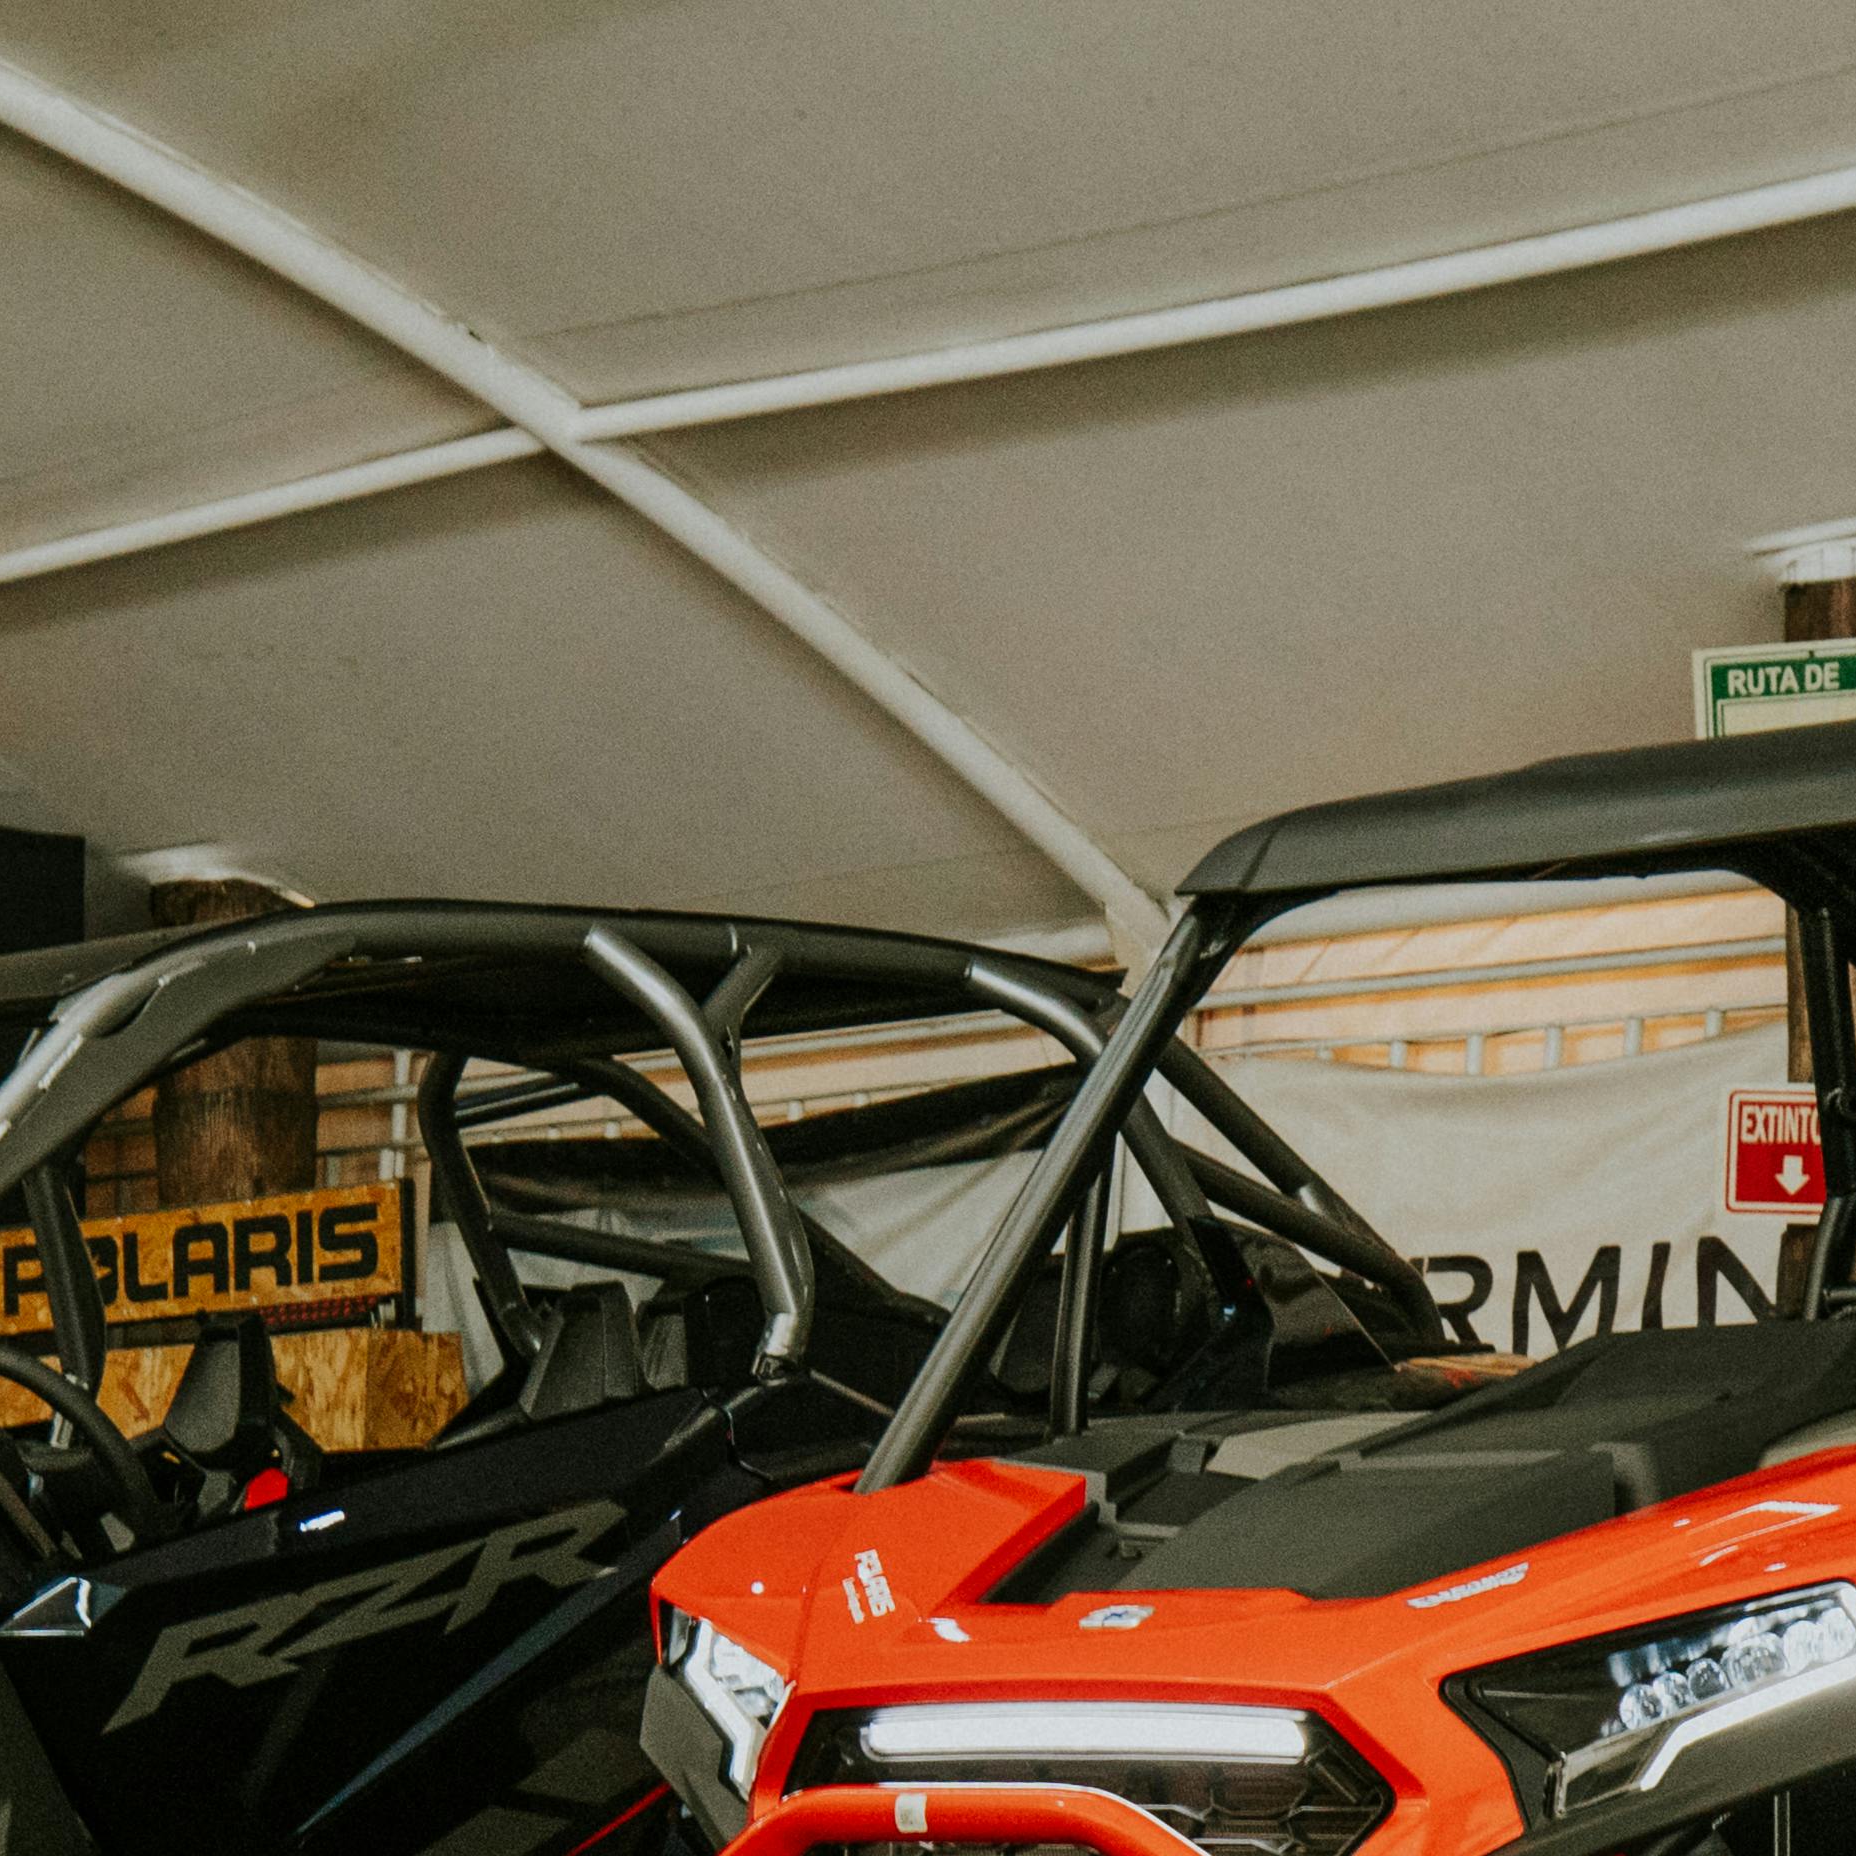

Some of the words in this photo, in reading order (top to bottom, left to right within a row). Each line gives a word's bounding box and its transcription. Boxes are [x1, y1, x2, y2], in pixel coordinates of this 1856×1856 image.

[1727, 666, 1800, 697] RUTA
[1804, 661, 1840, 690] DE
[102, 1497, 628, 1735] RZR
